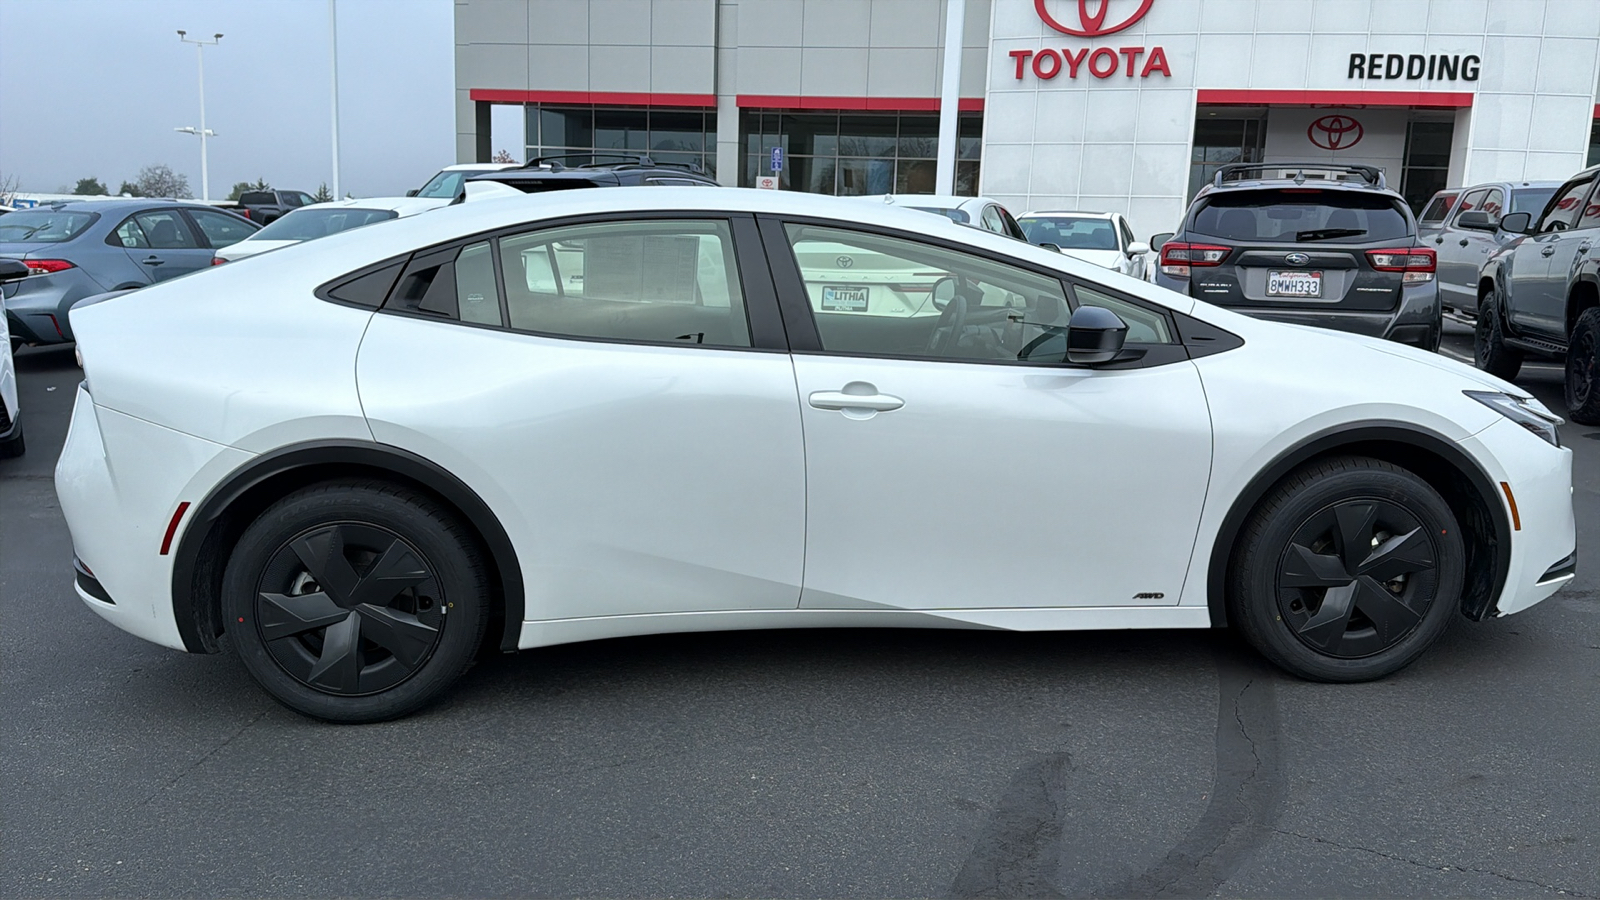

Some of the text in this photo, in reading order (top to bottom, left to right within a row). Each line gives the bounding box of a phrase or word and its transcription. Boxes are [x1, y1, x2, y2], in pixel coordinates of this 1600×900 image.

[1009, 47, 1172, 80] TOYOTA
[1347, 53, 1481, 82] REDDING
[834, 291, 865, 301] LITHIA
[1270, 279, 1318, 293] 8MWH333
